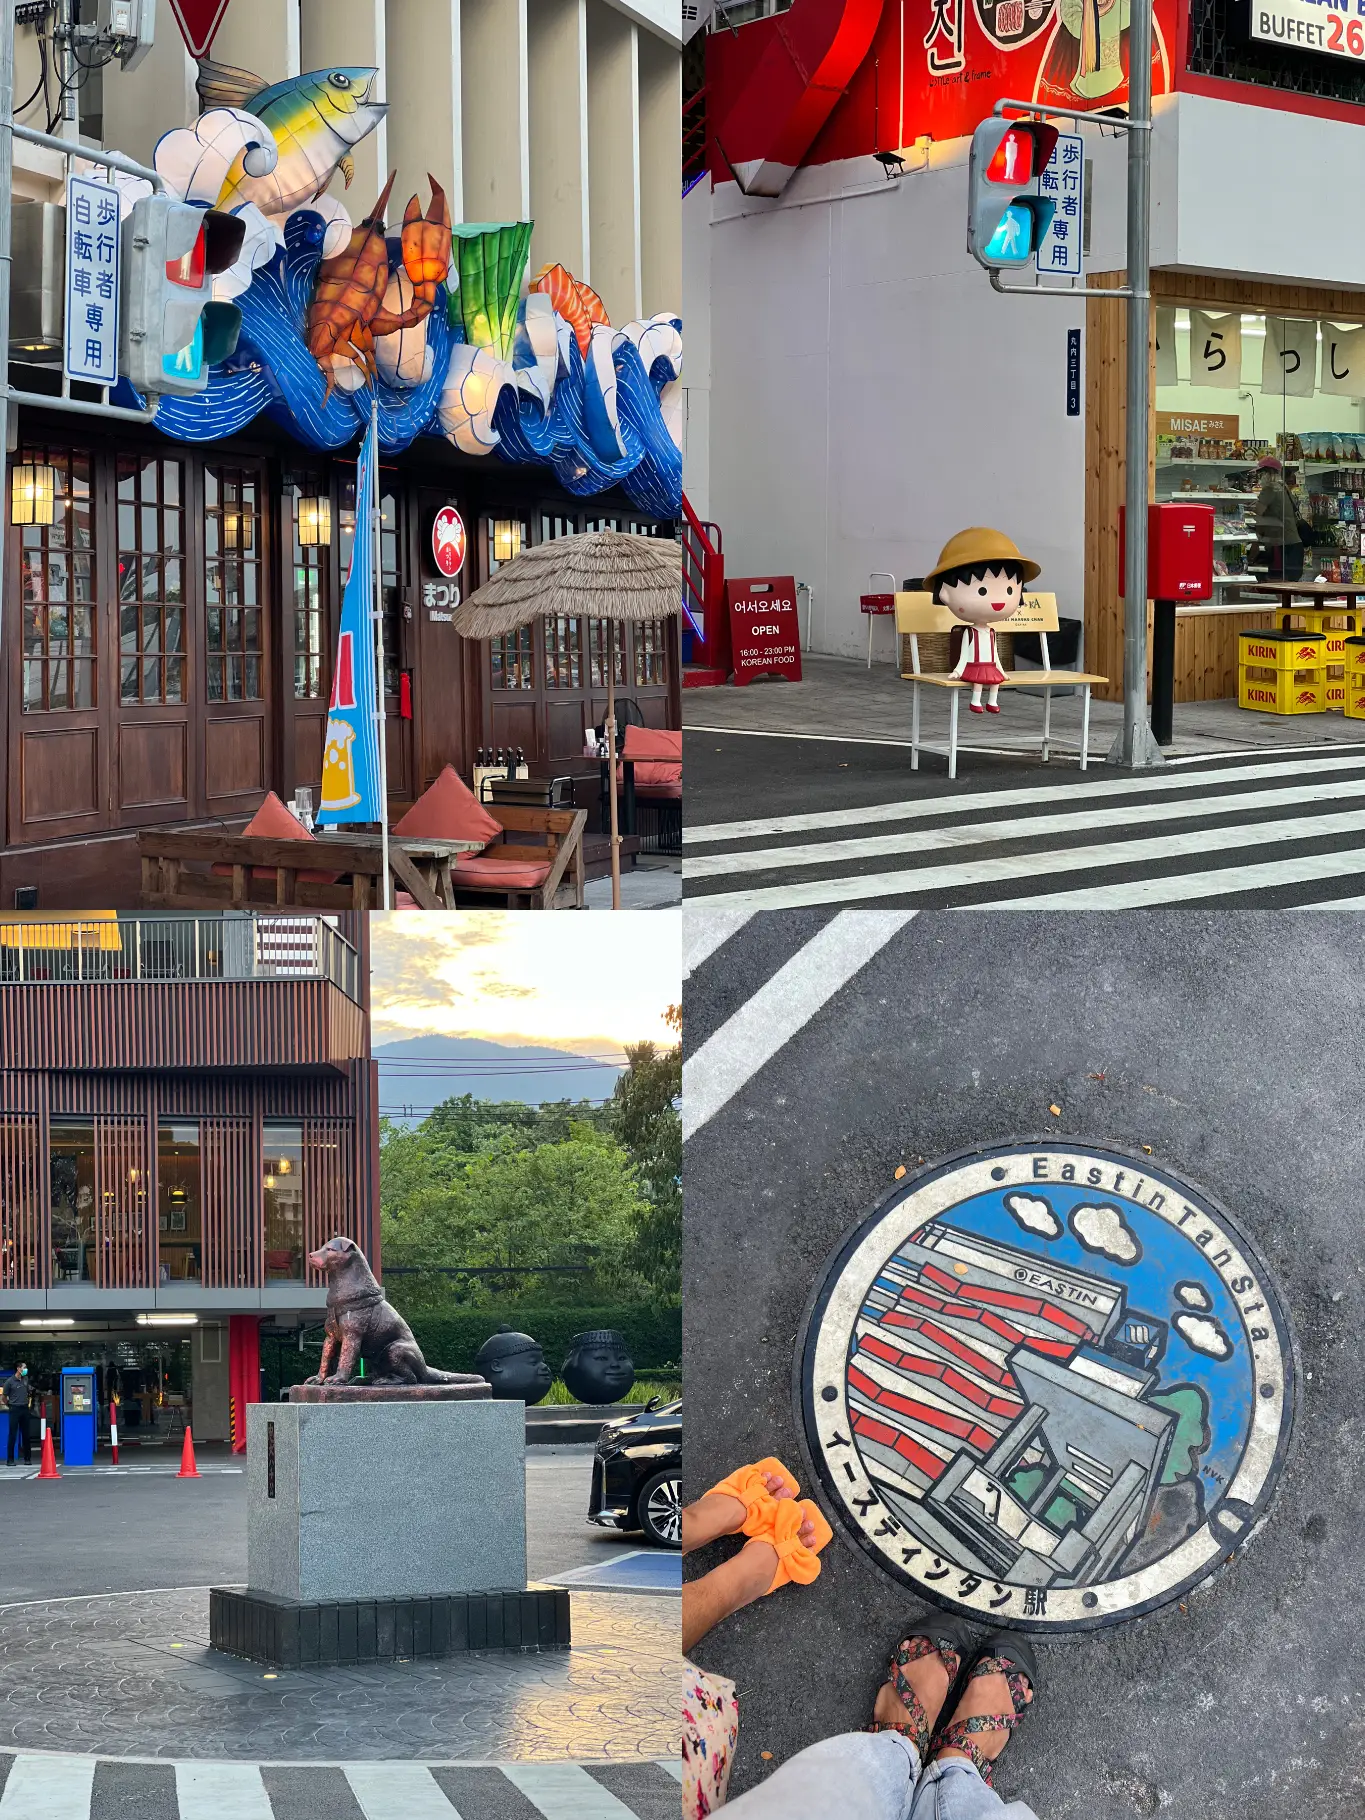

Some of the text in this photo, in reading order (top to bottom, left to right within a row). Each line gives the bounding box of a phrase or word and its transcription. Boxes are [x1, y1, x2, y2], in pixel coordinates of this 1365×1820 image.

[1260, 11, 1325, 46] BUFFET
[1062, 144, 1079, 217] 歩行者
[73, 194, 93, 298] 自転車
[96, 198, 116, 299] 歩行者
[1051, 219, 1069, 266] 専用
[83, 302, 104, 369] 専用
[1070, 397, 1076, 409] 3
[1170, 418, 1208, 432] MISAE
[423, 582, 460, 609] まつり
[734, 598, 793, 614] 어서오세요
[751, 625, 780, 636] OPEN
[740, 648, 759, 657] 16:00
[764, 646, 783, 656] 23:00
[784, 645, 795, 654] PM
[741, 655, 795, 667] KOREAN FOOD
[1248, 644, 1277, 660] KIRIN
[1247, 688, 1276, 704] KIRIN
[1032, 1157, 1166, 1211] Eastin
[1176, 1205, 1233, 1268] Tan
[1029, 1273, 1098, 1306] EASTIN
[826, 1431, 1048, 1616] イースティンタン駅
